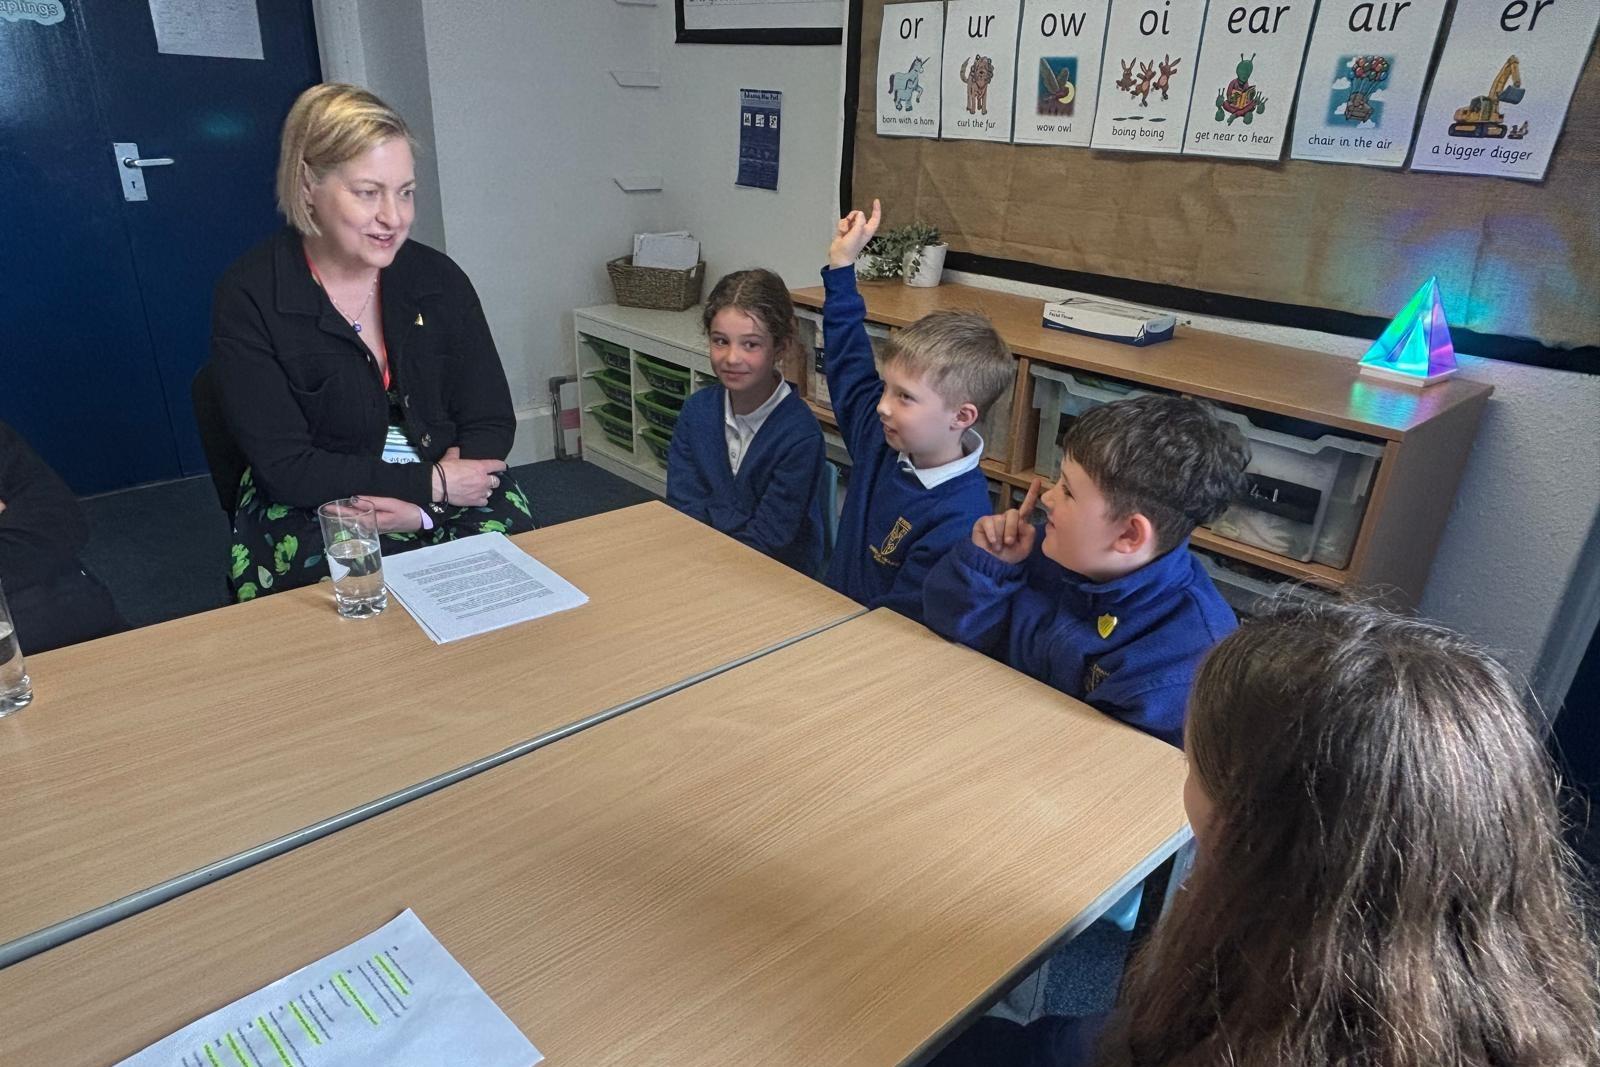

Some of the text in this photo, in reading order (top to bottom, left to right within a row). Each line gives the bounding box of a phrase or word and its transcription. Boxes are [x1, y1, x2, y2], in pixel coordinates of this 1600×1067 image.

[967, 13, 996, 38] ur
[1040, 11, 1087, 37] ow
[1139, 1, 1171, 36] oi
[1227, 5, 1291, 34] ear
[1348, 1, 1411, 32] air
[1499, 0, 1554, 32] er
[899, 17, 924, 40] or
[882, 114, 897, 124] born
[898, 116, 912, 125] with
[920, 117, 935, 126] horn
[957, 119, 997, 132] curl the fur
[1036, 122, 1073, 133] wow owl
[1112, 126, 1165, 141] boing boing
[1195, 131, 1274, 144] get near to hear
[1308, 134, 1392, 149] chair in the air
[1431, 143, 1533, 163] a bigger digger
